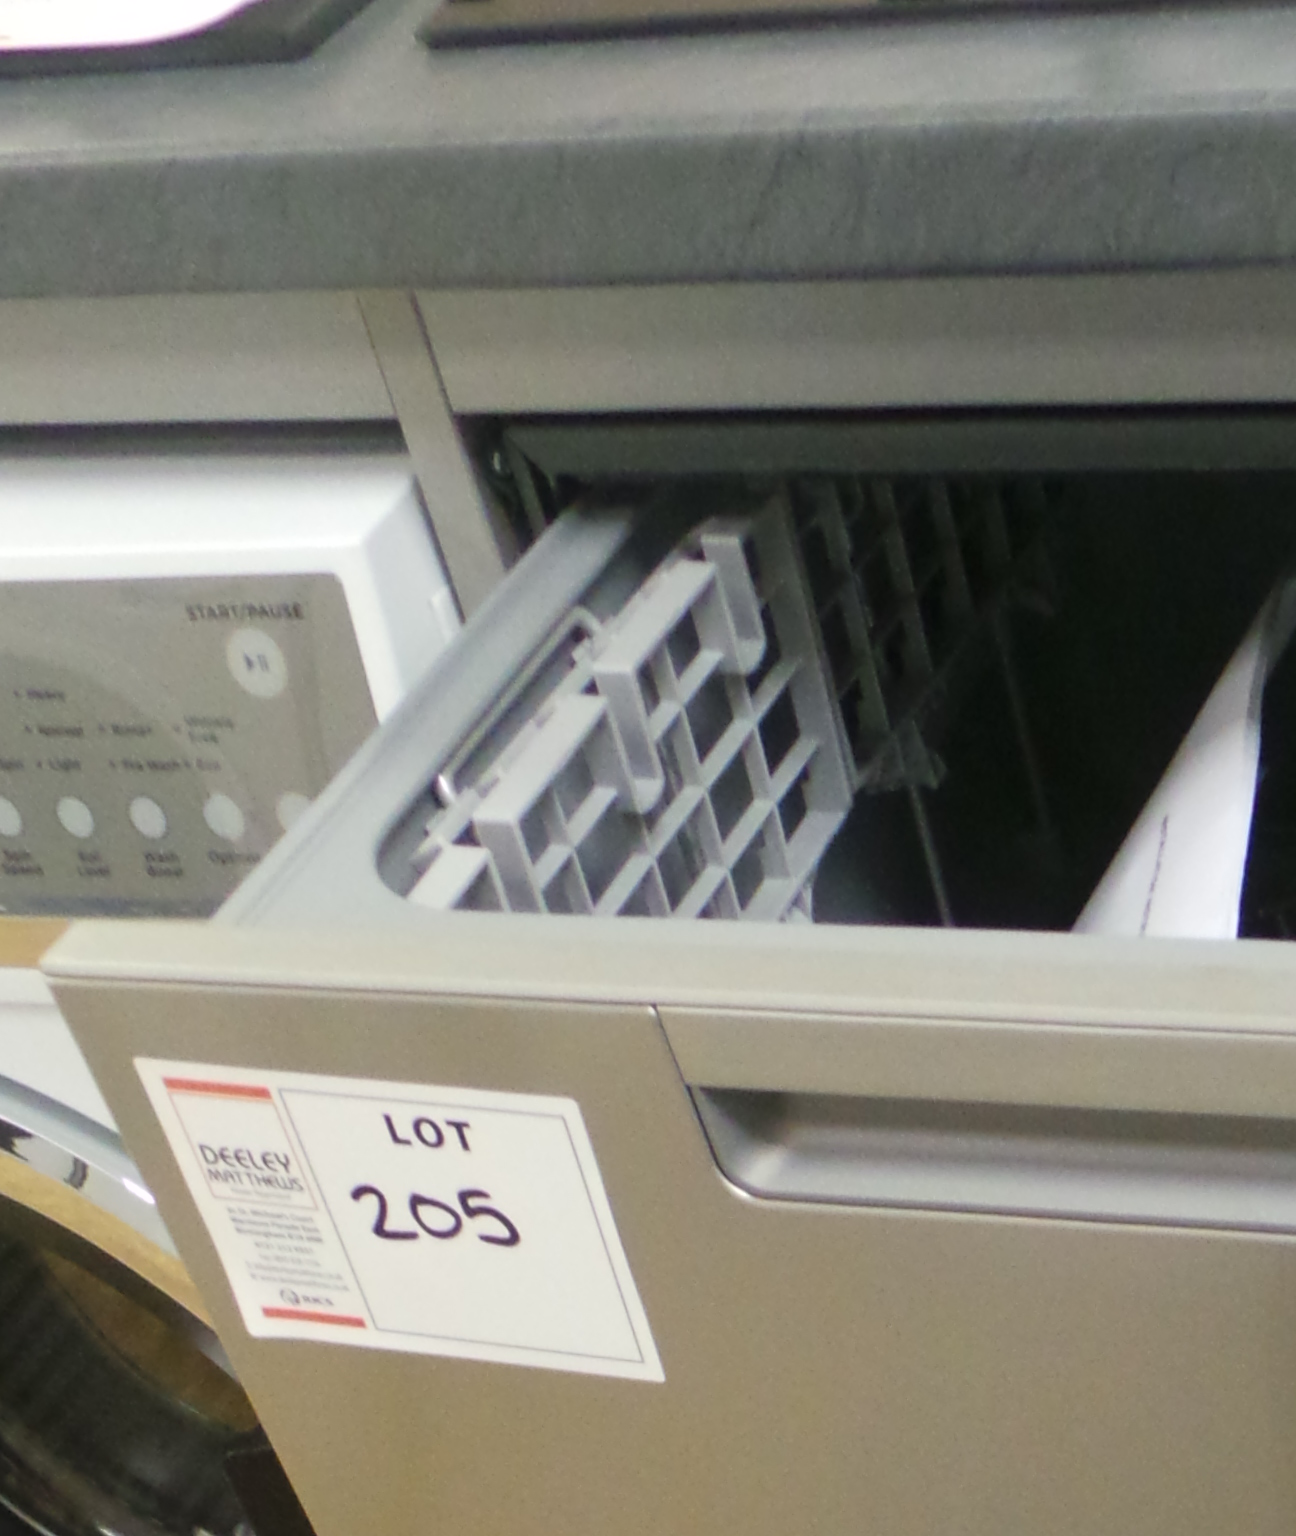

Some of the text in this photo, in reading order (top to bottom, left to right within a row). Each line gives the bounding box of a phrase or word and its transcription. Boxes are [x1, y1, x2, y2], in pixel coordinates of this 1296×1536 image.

[185, 601, 306, 621] START/PAUSE
[383, 1113, 472, 1152] LOT
[199, 1144, 290, 1174] DEELEY
[206, 1167, 304, 1192] MATTHEWS
[351, 1184, 521, 1247] 205
